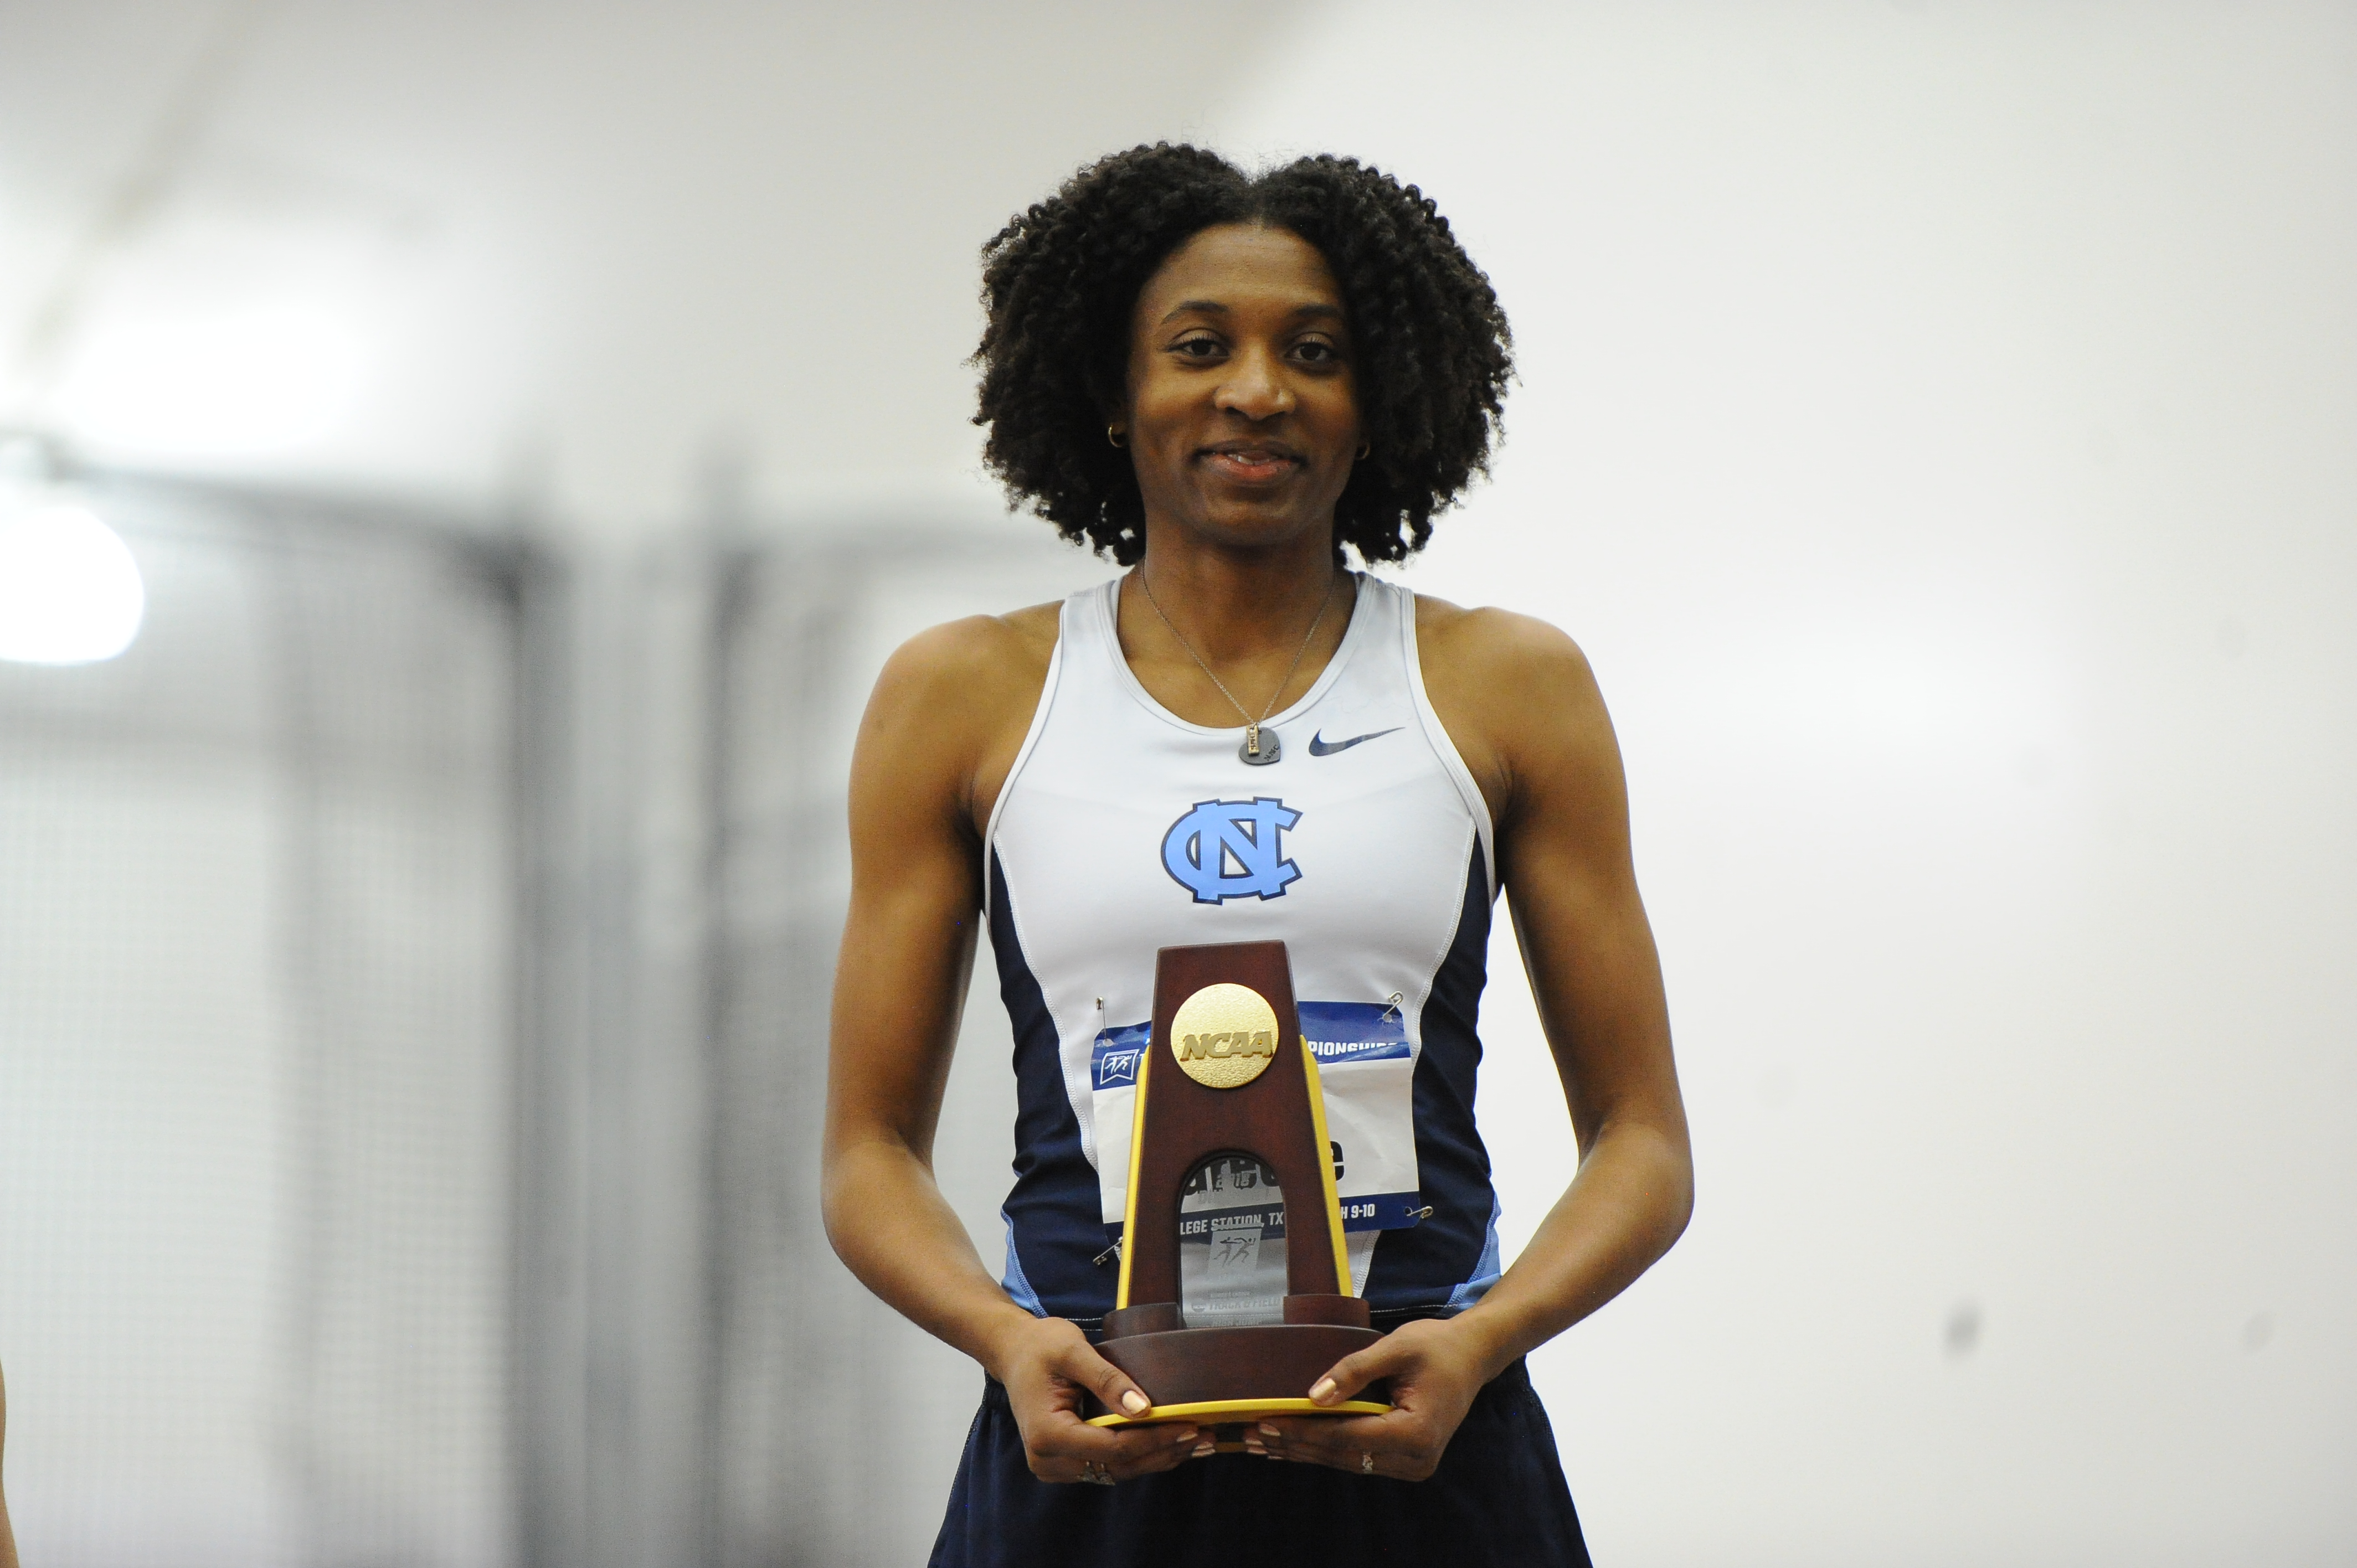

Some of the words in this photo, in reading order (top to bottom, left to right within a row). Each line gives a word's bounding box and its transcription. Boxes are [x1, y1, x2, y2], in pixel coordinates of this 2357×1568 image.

[1180, 1031, 1274, 1062] NCAA
[1180, 1219, 1208, 1235] LEGE
[1211, 1214, 1265, 1231] STATION,
[1268, 1211, 1284, 1226] TX
[1351, 1203, 1376, 1219] 9-10
[1210, 1302, 1242, 1311] TRACK
